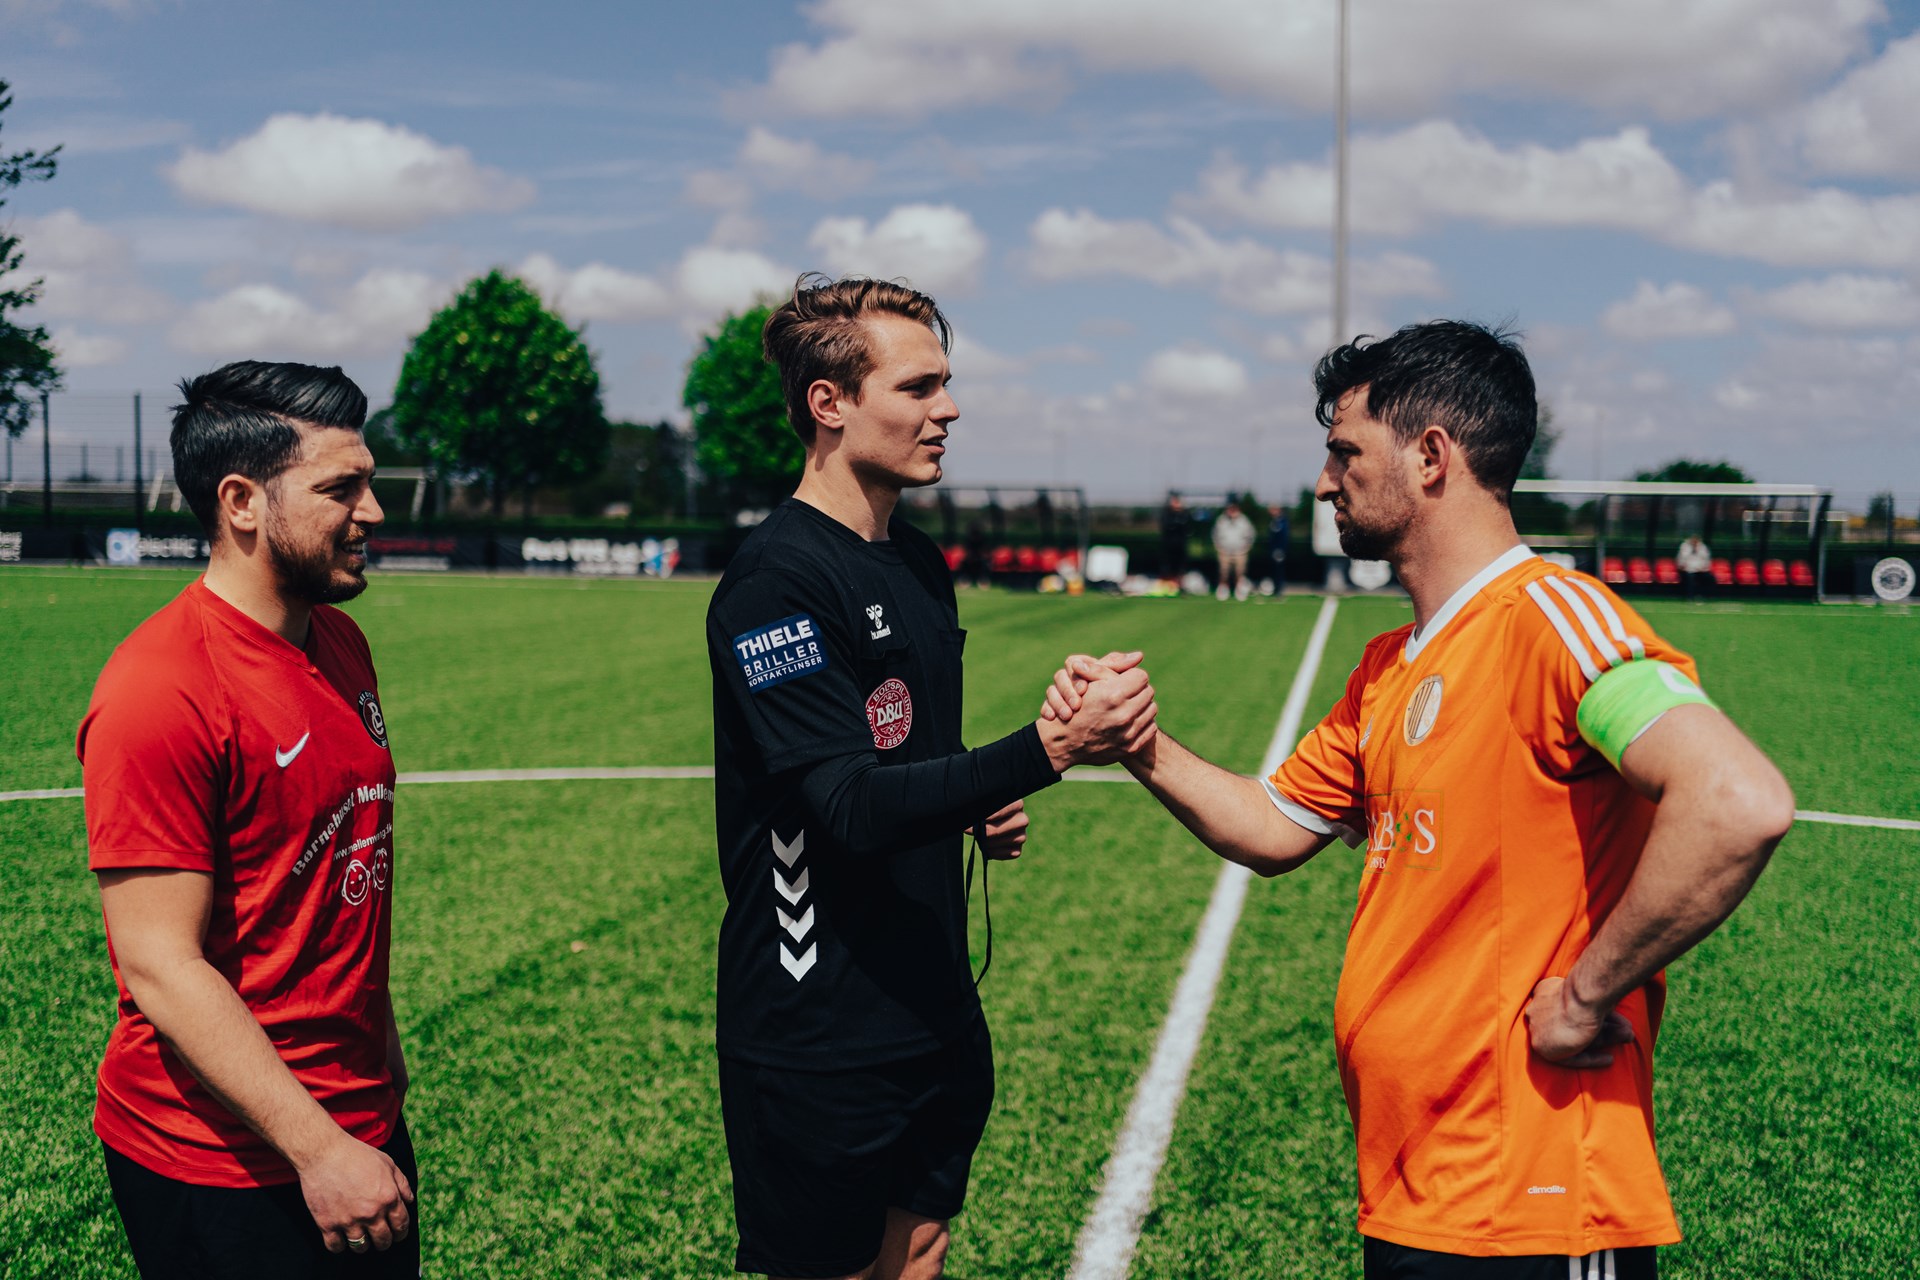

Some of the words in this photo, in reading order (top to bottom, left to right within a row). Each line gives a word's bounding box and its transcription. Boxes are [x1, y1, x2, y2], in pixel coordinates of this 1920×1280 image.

[737, 619, 814, 660] THIELE
[744, 641, 819, 677] BRILLER
[748, 656, 823, 688] KONTAKTLINSER
[876, 700, 904, 727] DBU
[883, 733, 903, 747] 1889
